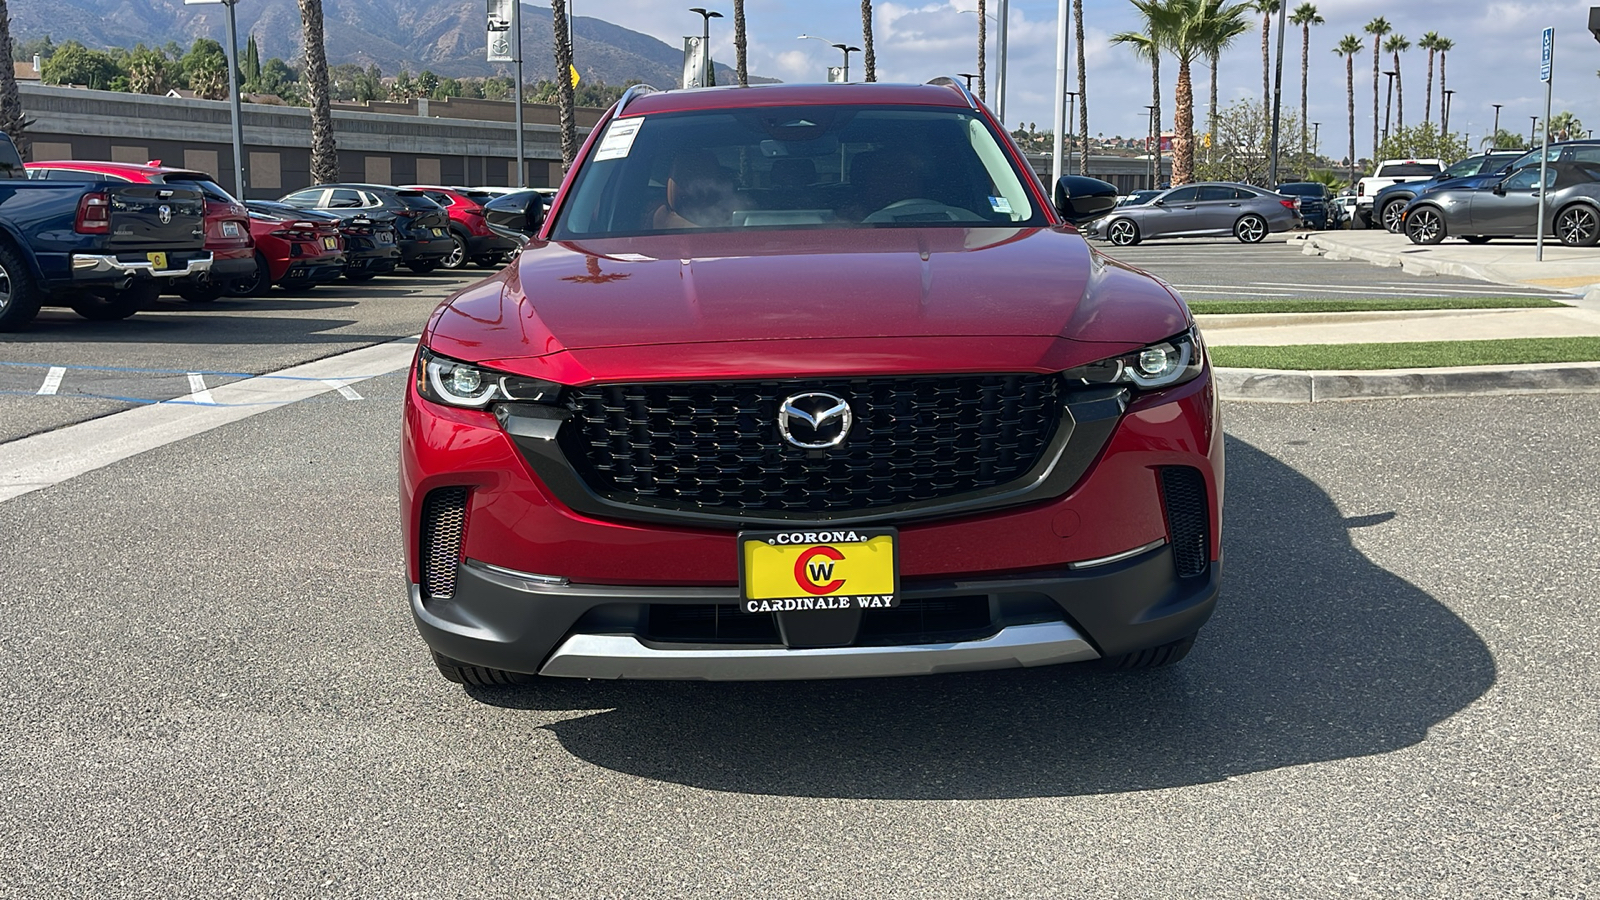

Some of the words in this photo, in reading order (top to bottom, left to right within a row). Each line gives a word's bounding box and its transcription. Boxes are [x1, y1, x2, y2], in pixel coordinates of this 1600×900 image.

[776, 531, 859, 544] CORONA
[808, 560, 835, 582] W
[747, 597, 851, 613] CARDINALE
[857, 595, 894, 608] WAY
